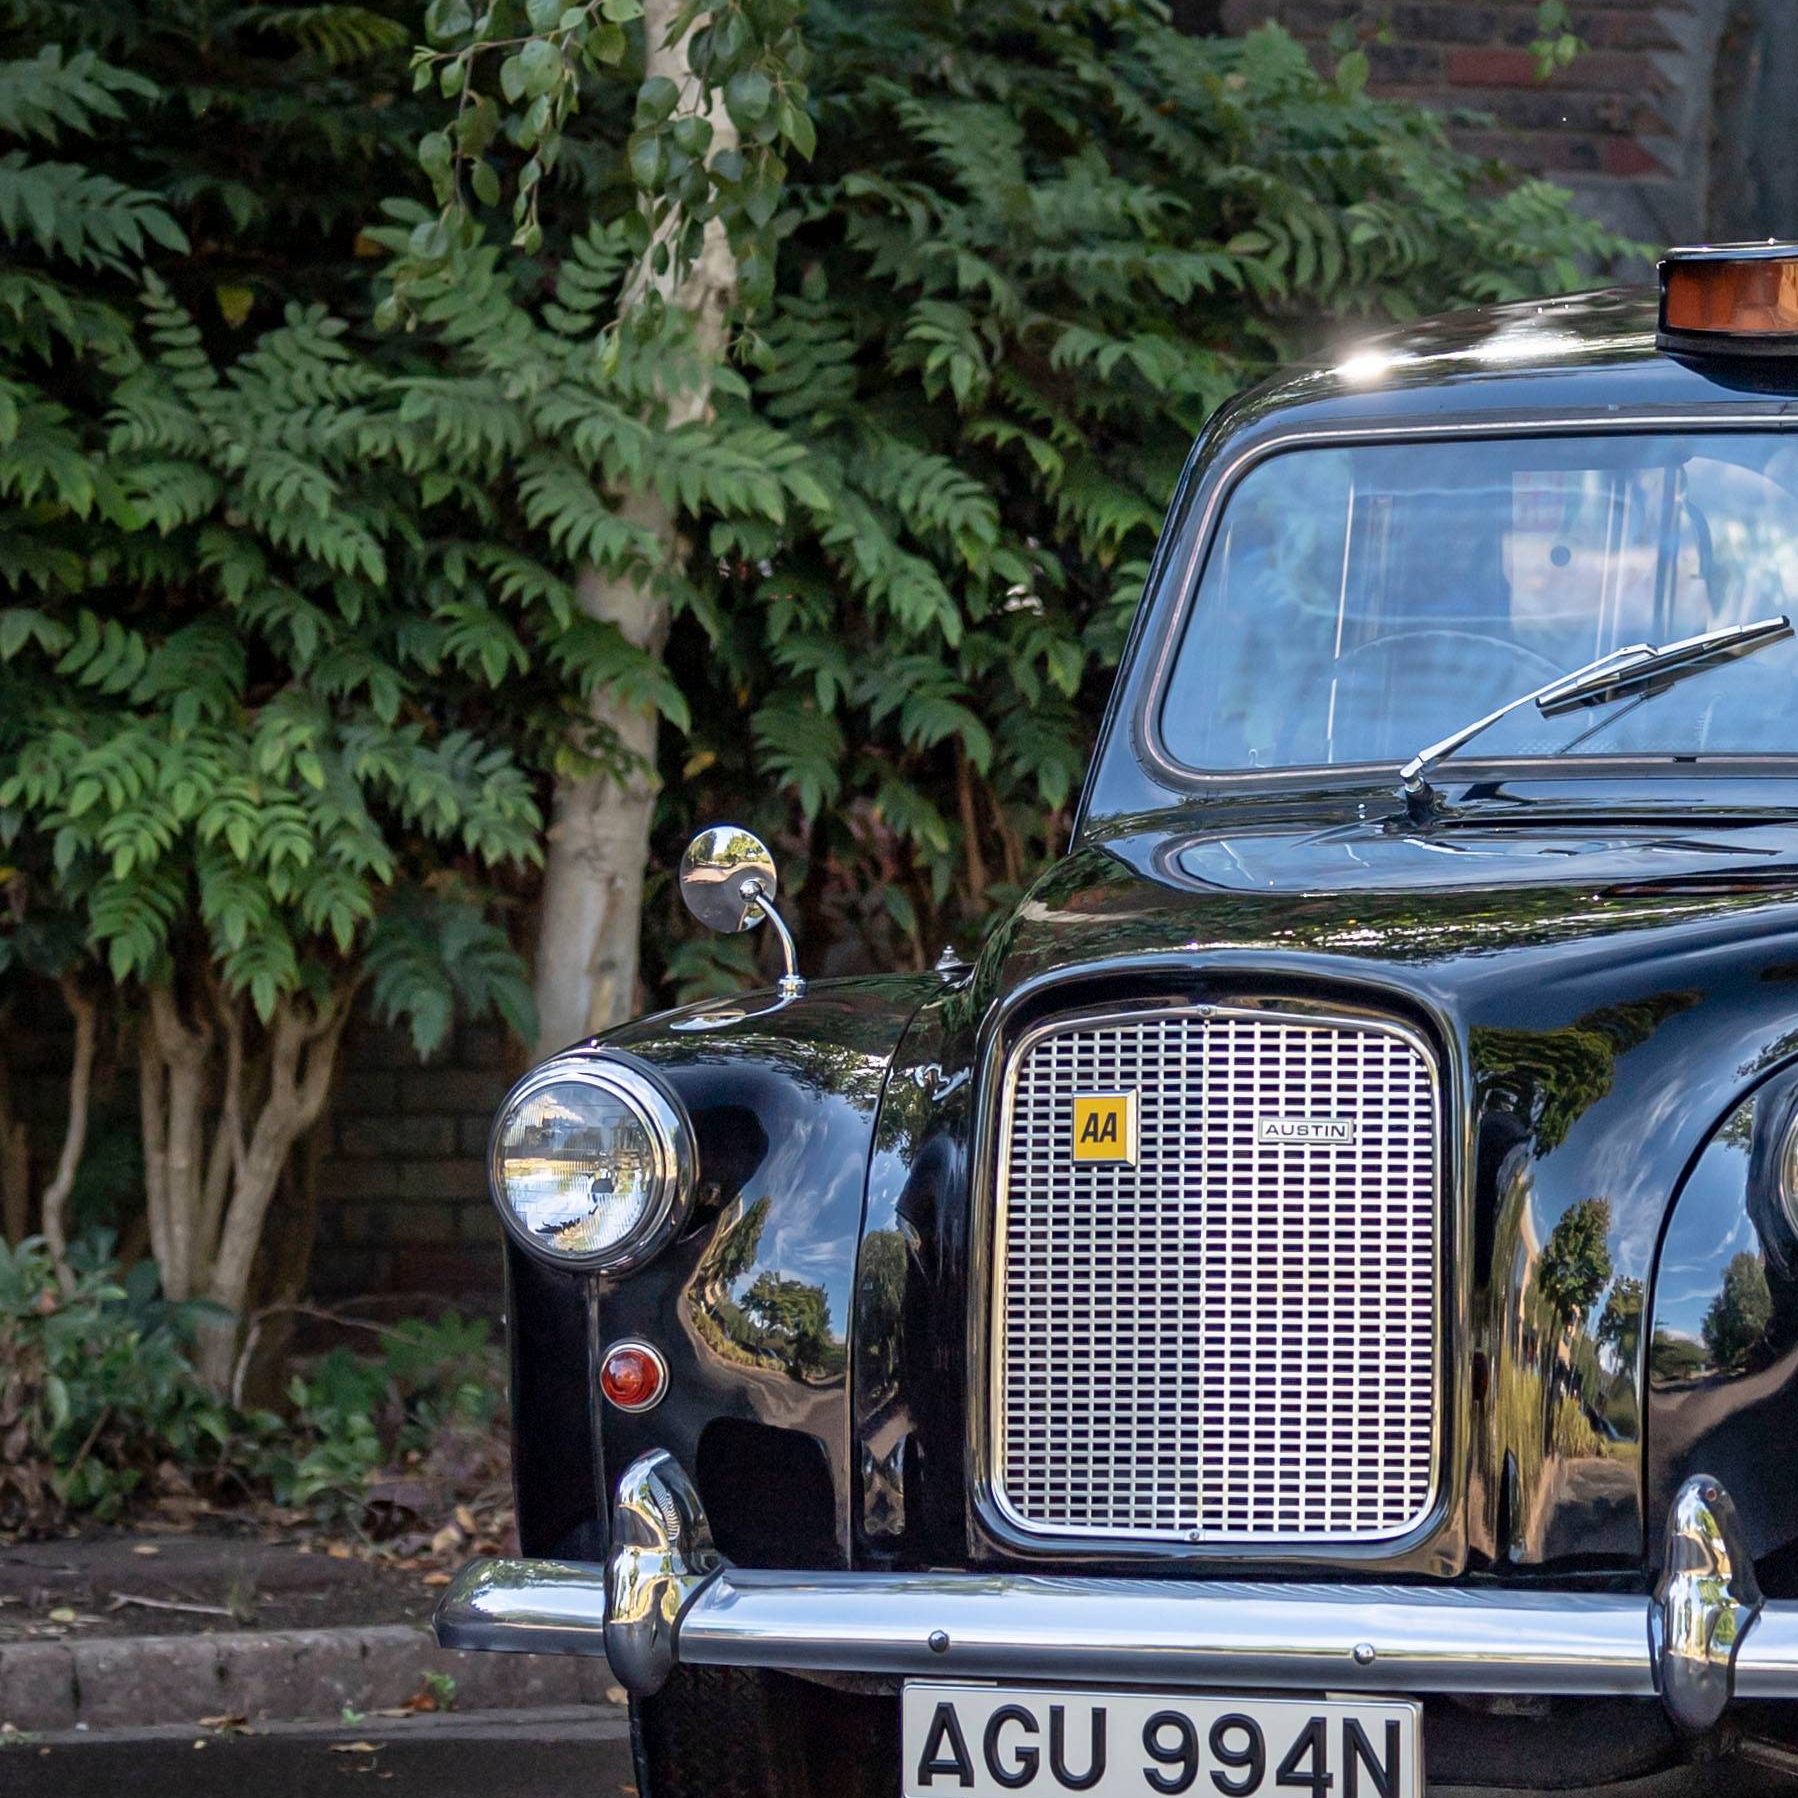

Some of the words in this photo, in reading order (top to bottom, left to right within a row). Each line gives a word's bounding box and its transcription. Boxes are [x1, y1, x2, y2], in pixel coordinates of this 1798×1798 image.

[1080, 1111, 1117, 1143] AA
[1265, 1124, 1345, 1137] AUSTIN
[917, 1701, 1107, 1790] AGU
